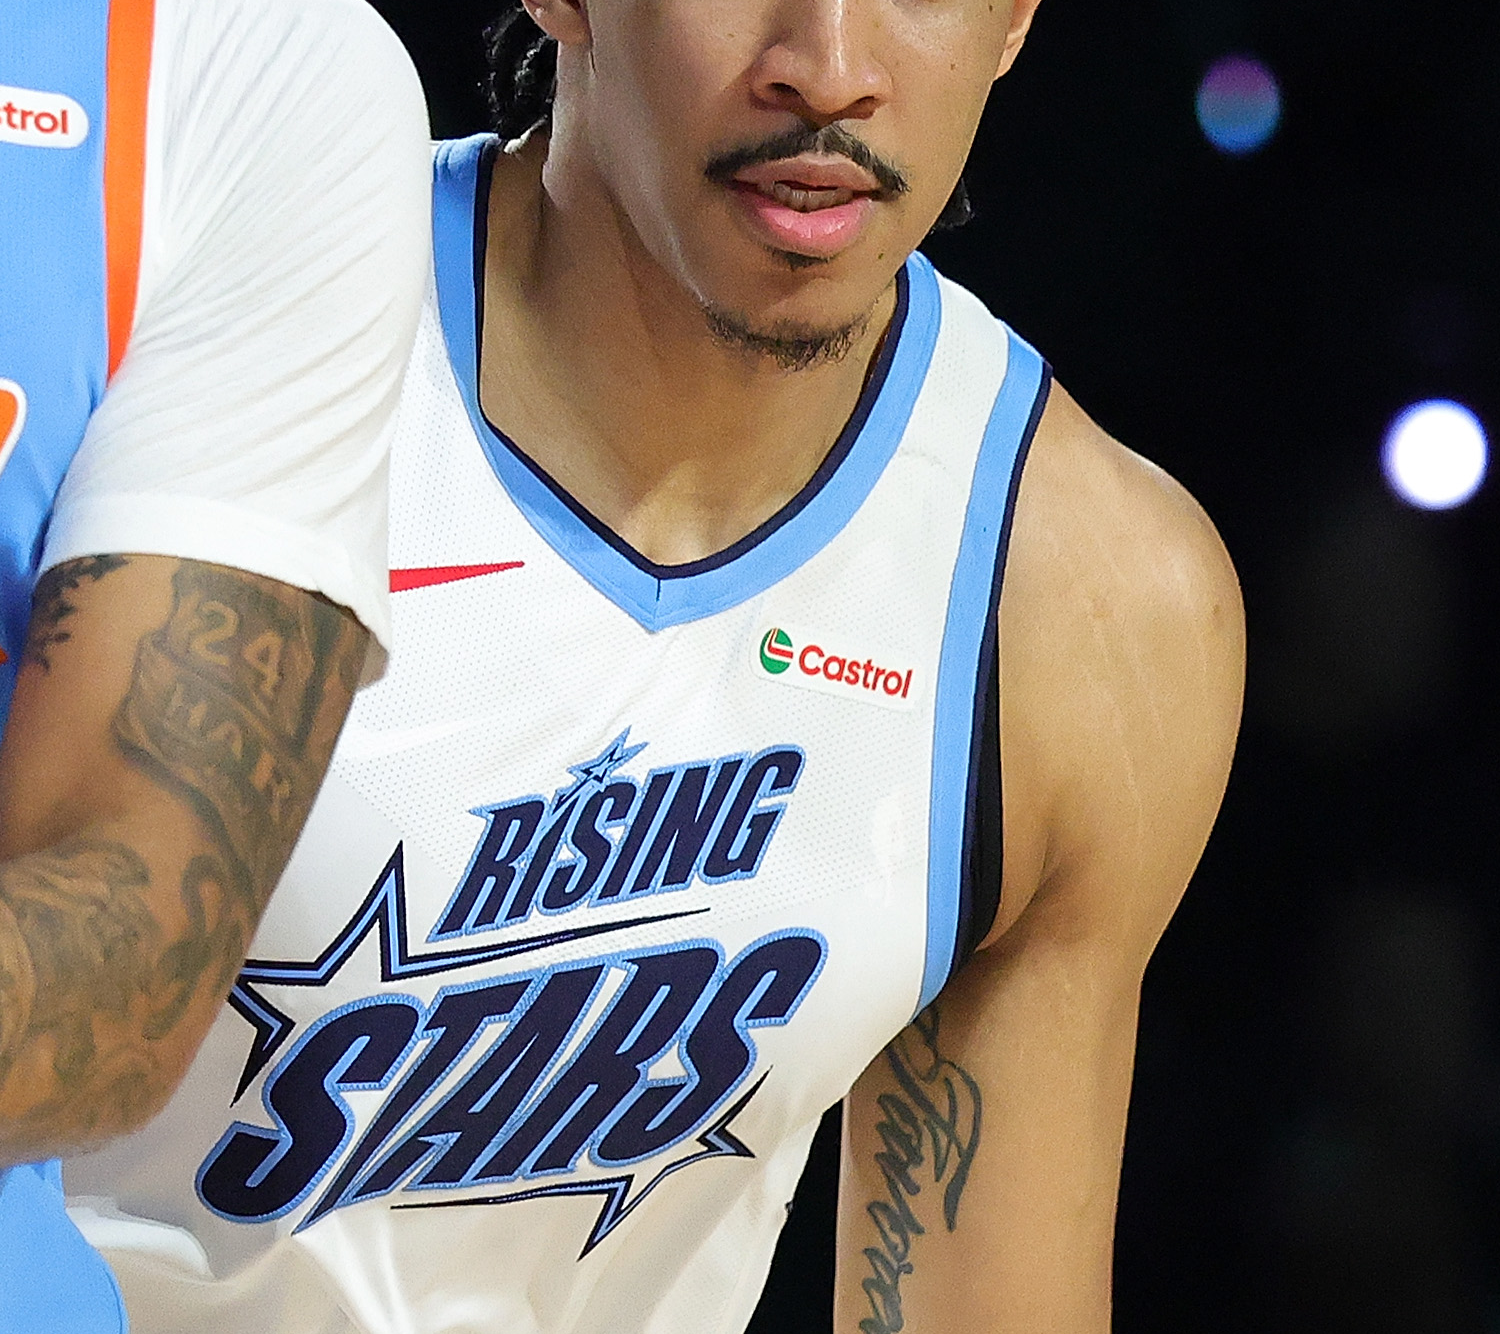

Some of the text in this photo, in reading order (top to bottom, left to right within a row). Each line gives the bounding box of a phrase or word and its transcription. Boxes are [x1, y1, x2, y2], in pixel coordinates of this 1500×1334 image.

[798, 644, 913, 699] Castrol
[425, 743, 806, 943] RISING
[195, 926, 829, 1236] STARS
